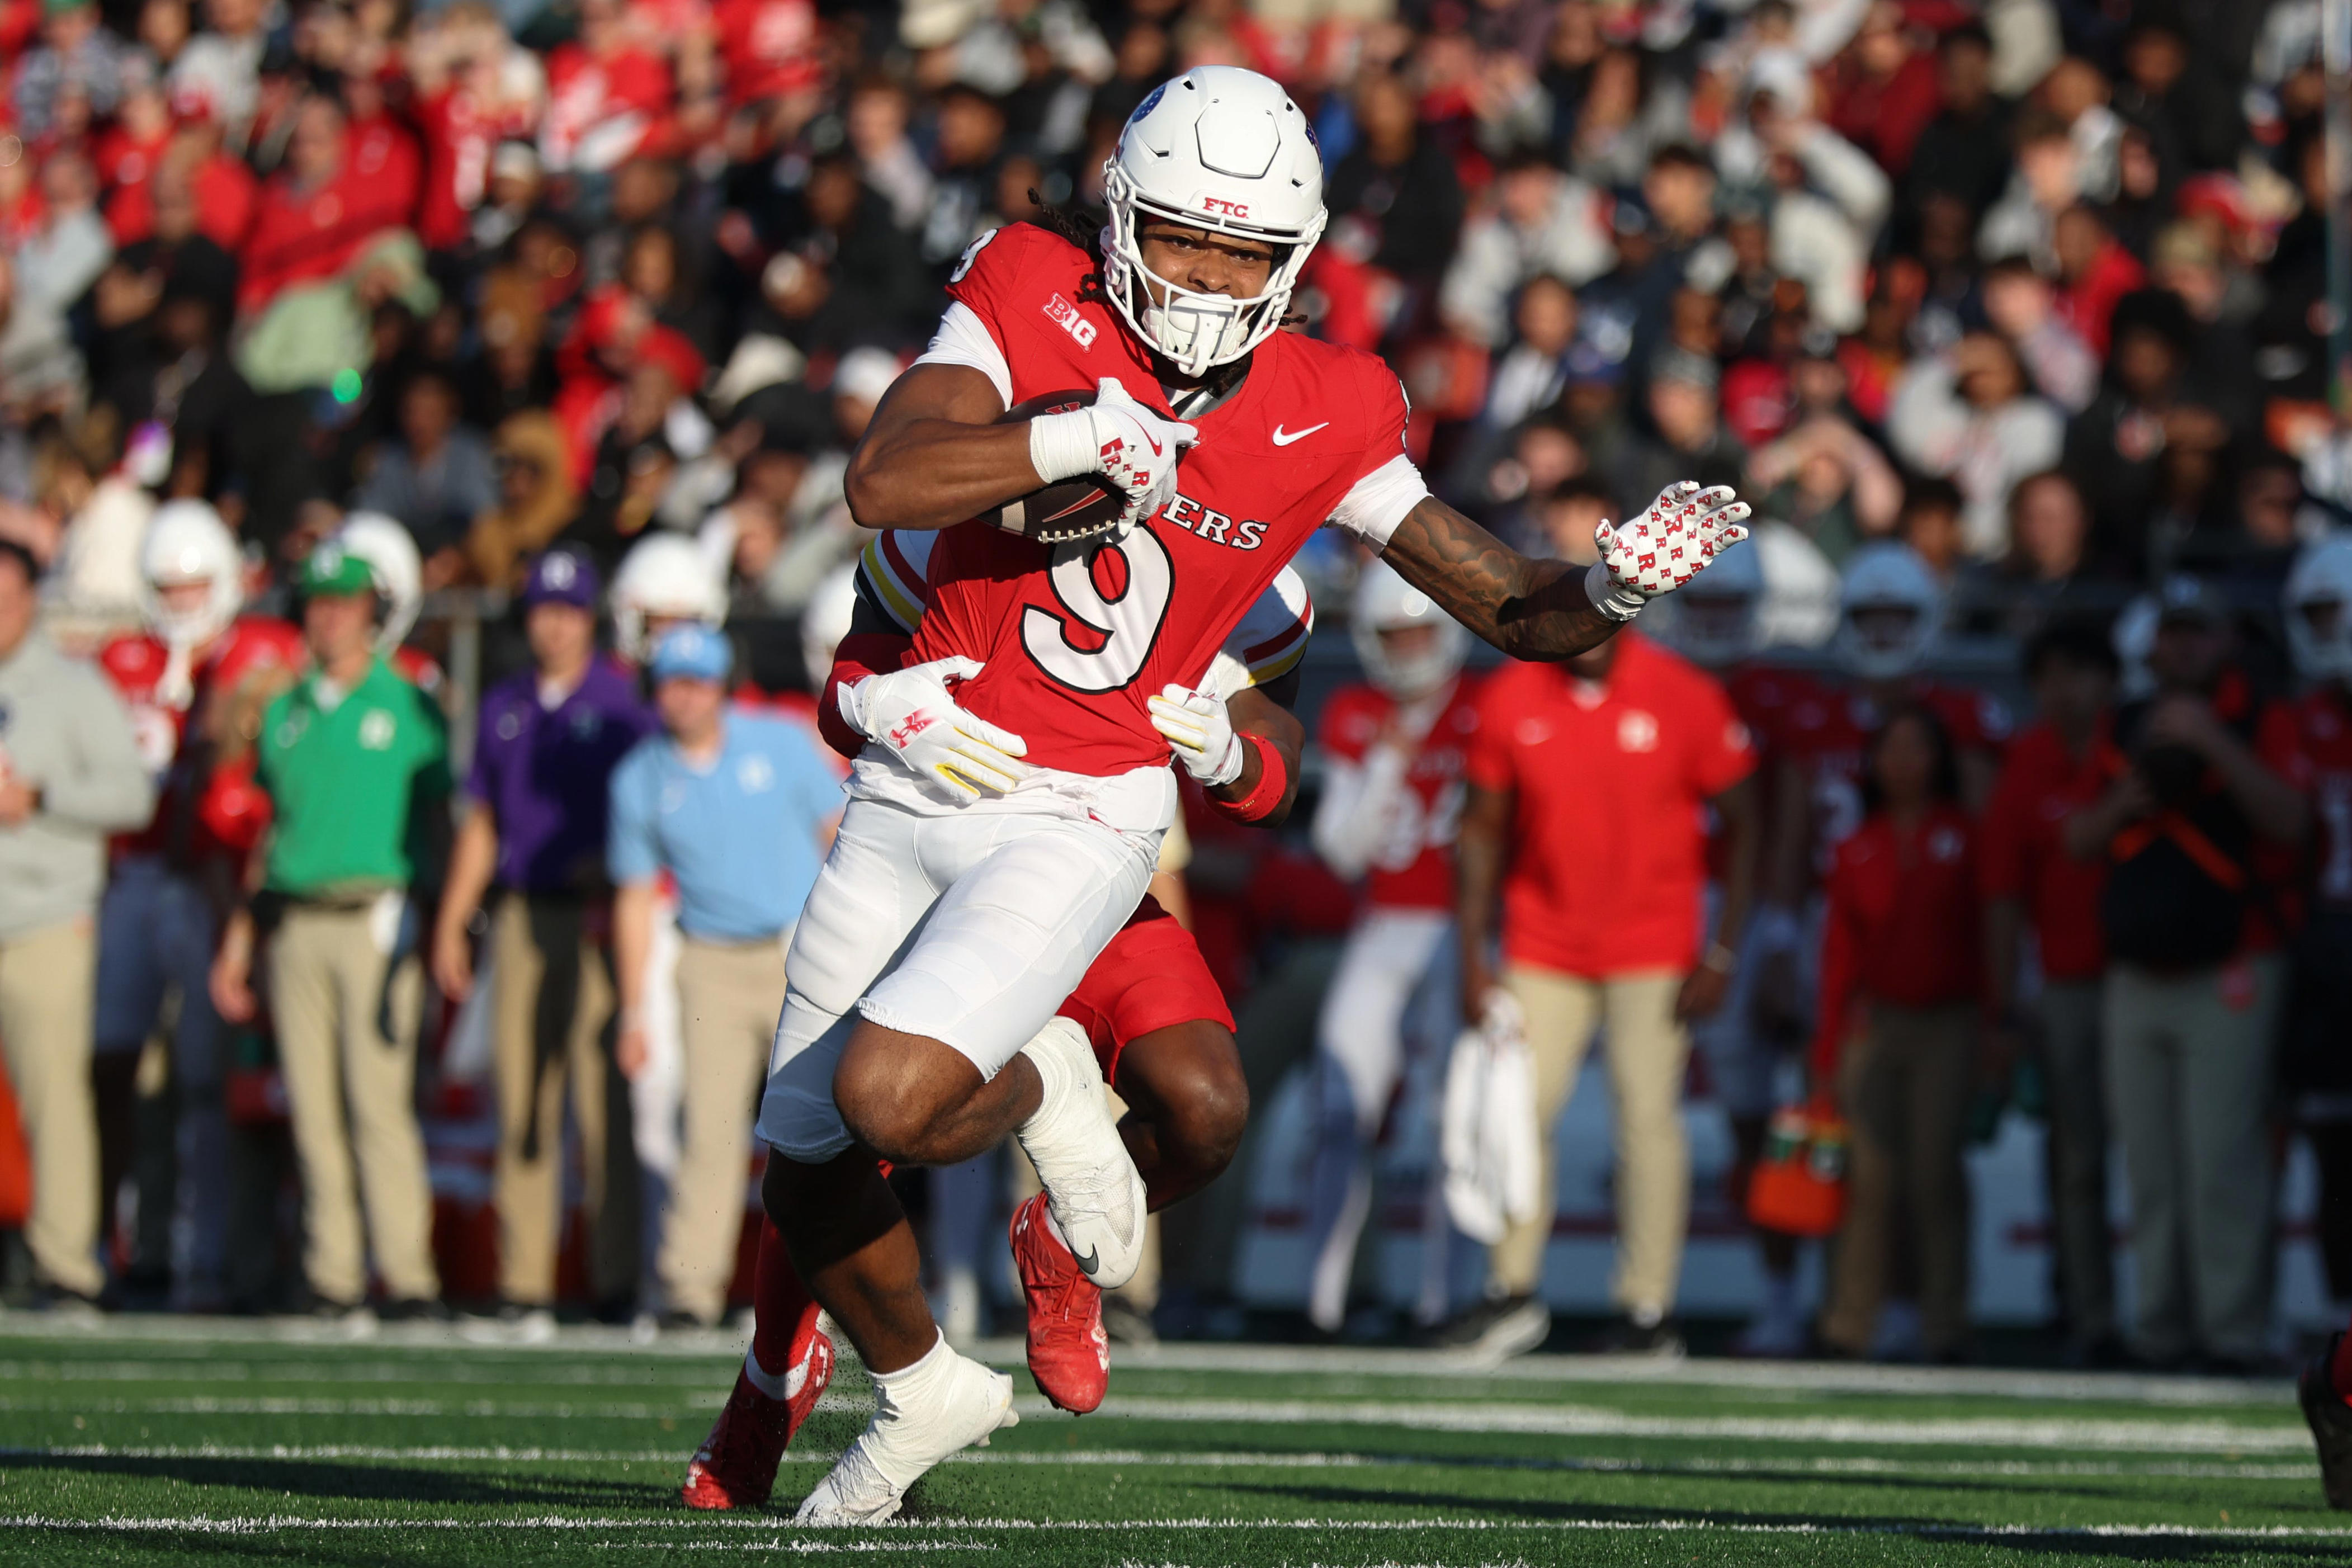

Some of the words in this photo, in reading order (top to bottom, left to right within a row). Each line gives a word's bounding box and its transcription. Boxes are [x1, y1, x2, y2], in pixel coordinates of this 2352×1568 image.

[1132, 470, 1150, 486] R
[1684, 504, 1696, 516] R
[1163, 492, 1271, 550] ERS
[1664, 514, 1683, 536] R
[1656, 537, 1667, 550] R
[1671, 546, 1683, 561] R
[1638, 552, 1656, 573] R
[1660, 568, 1671, 579] R
[1019, 523, 1176, 695] 9
